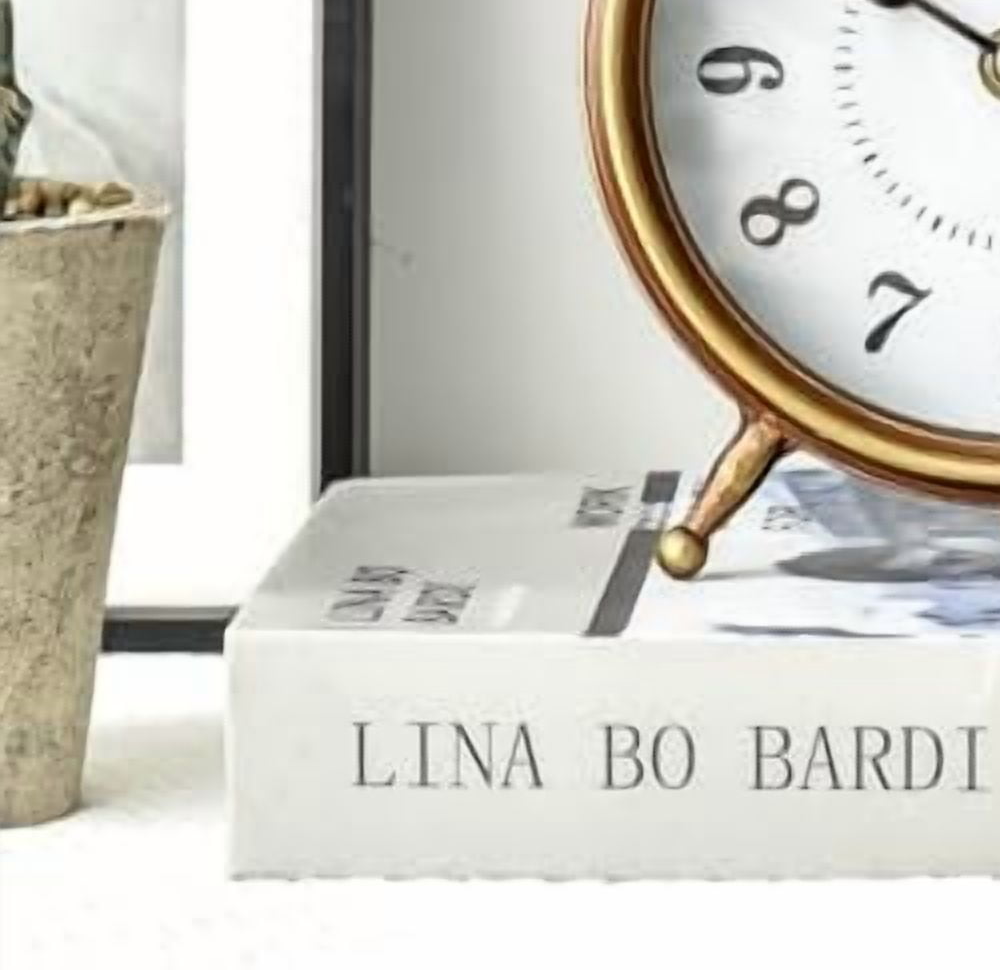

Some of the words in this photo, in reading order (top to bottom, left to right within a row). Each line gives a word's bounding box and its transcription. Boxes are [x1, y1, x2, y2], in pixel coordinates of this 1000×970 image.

[695, 44, 785, 96] 9
[738, 177, 821, 249] 8
[864, 270, 932, 355] 7
[352, 721, 545, 789] LINA
[601, 724, 697, 791] BO
[748, 724, 990, 793] BARDI
